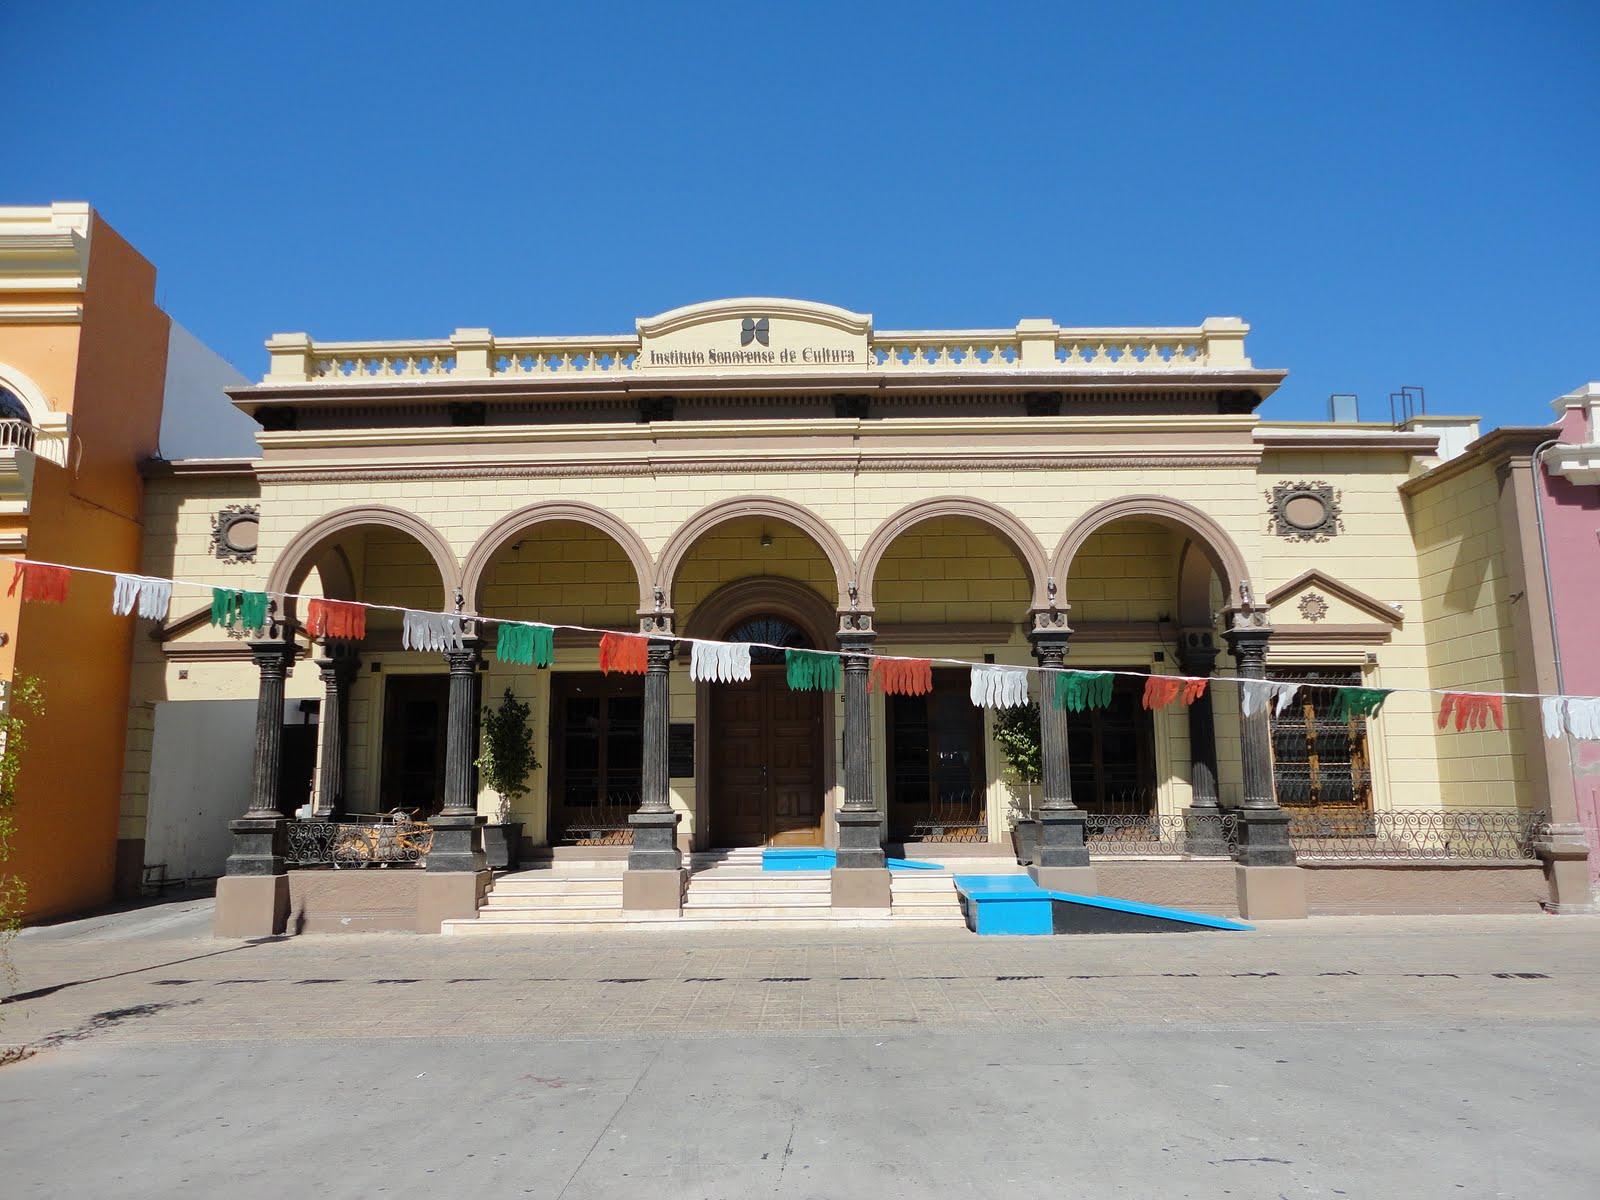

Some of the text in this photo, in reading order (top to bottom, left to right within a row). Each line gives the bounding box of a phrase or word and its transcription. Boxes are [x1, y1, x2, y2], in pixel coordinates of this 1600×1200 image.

[650, 347, 855, 365] Instituto Sonorense de Cultura
